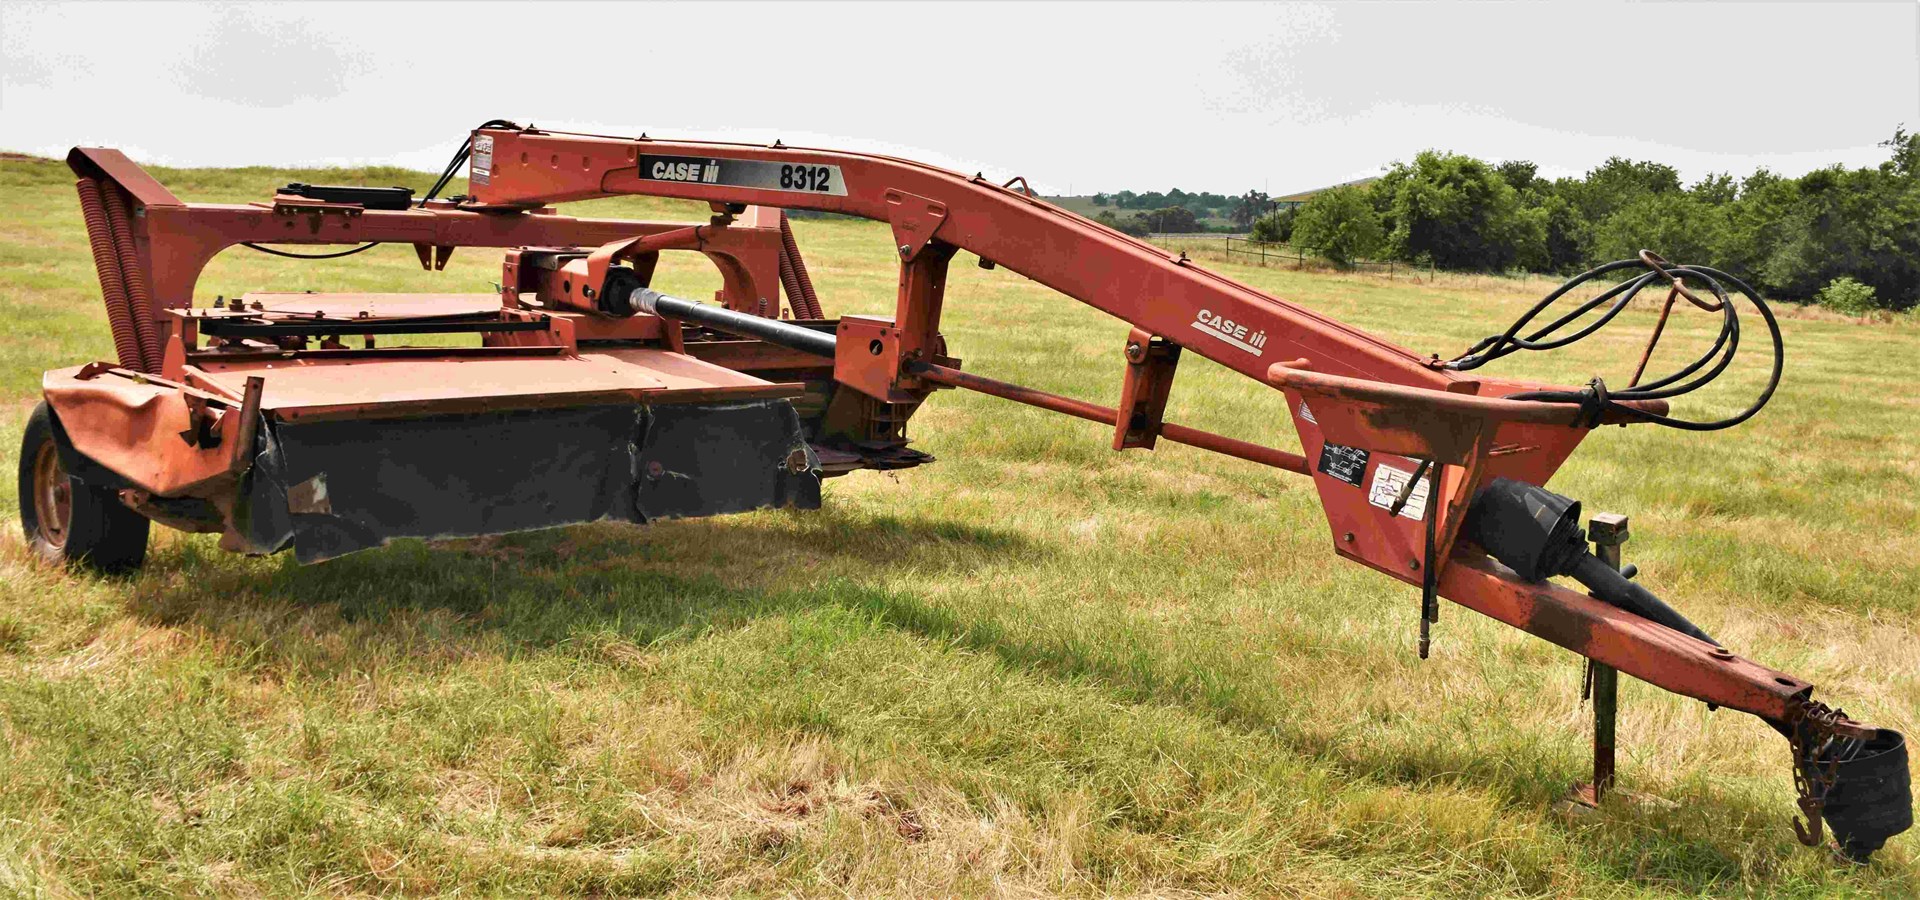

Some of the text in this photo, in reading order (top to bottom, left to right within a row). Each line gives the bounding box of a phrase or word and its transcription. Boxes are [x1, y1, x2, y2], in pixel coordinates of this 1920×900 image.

[652, 161, 700, 181] CASE
[780, 165, 830, 191] 8312
[1197, 309, 1248, 340] CASE
